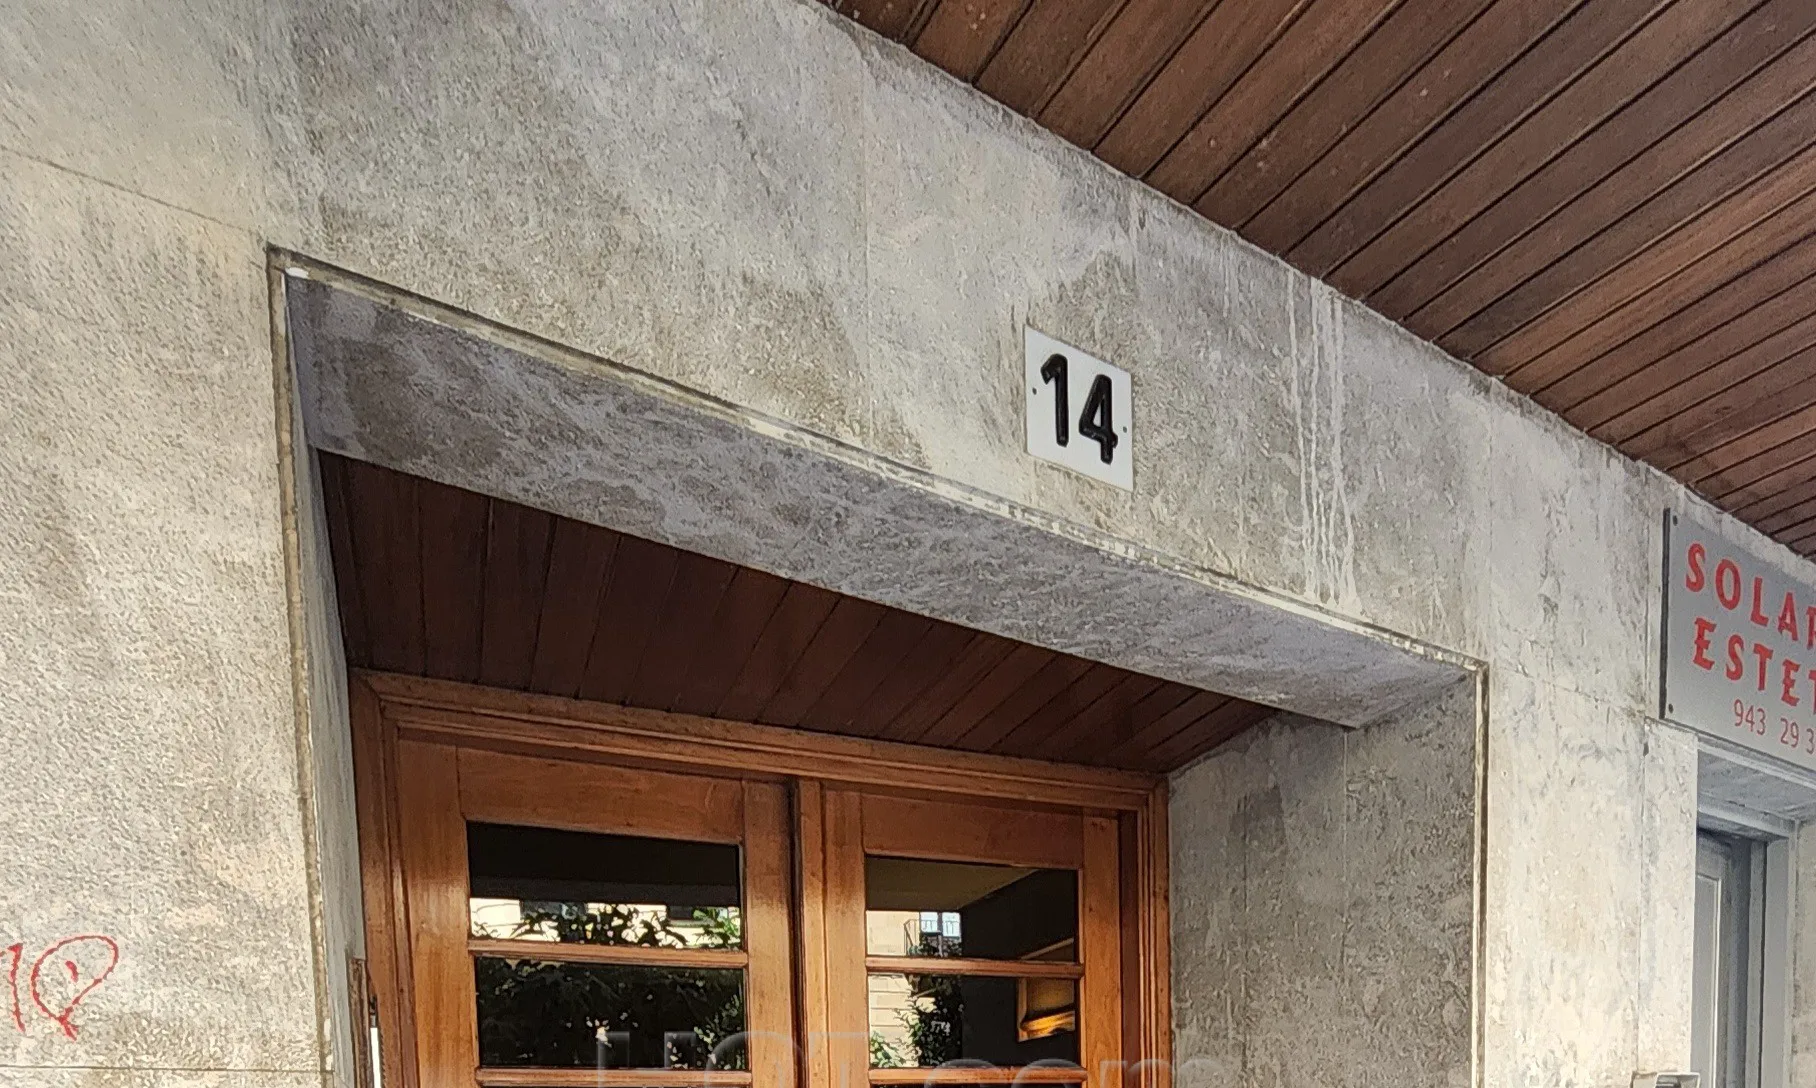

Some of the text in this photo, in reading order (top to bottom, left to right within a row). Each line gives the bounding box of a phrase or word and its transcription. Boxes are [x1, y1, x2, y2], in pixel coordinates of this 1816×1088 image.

[1040, 353, 1118, 465] 14
[1733, 698, 1766, 736] 943
[1780, 717, 1799, 748] 29
